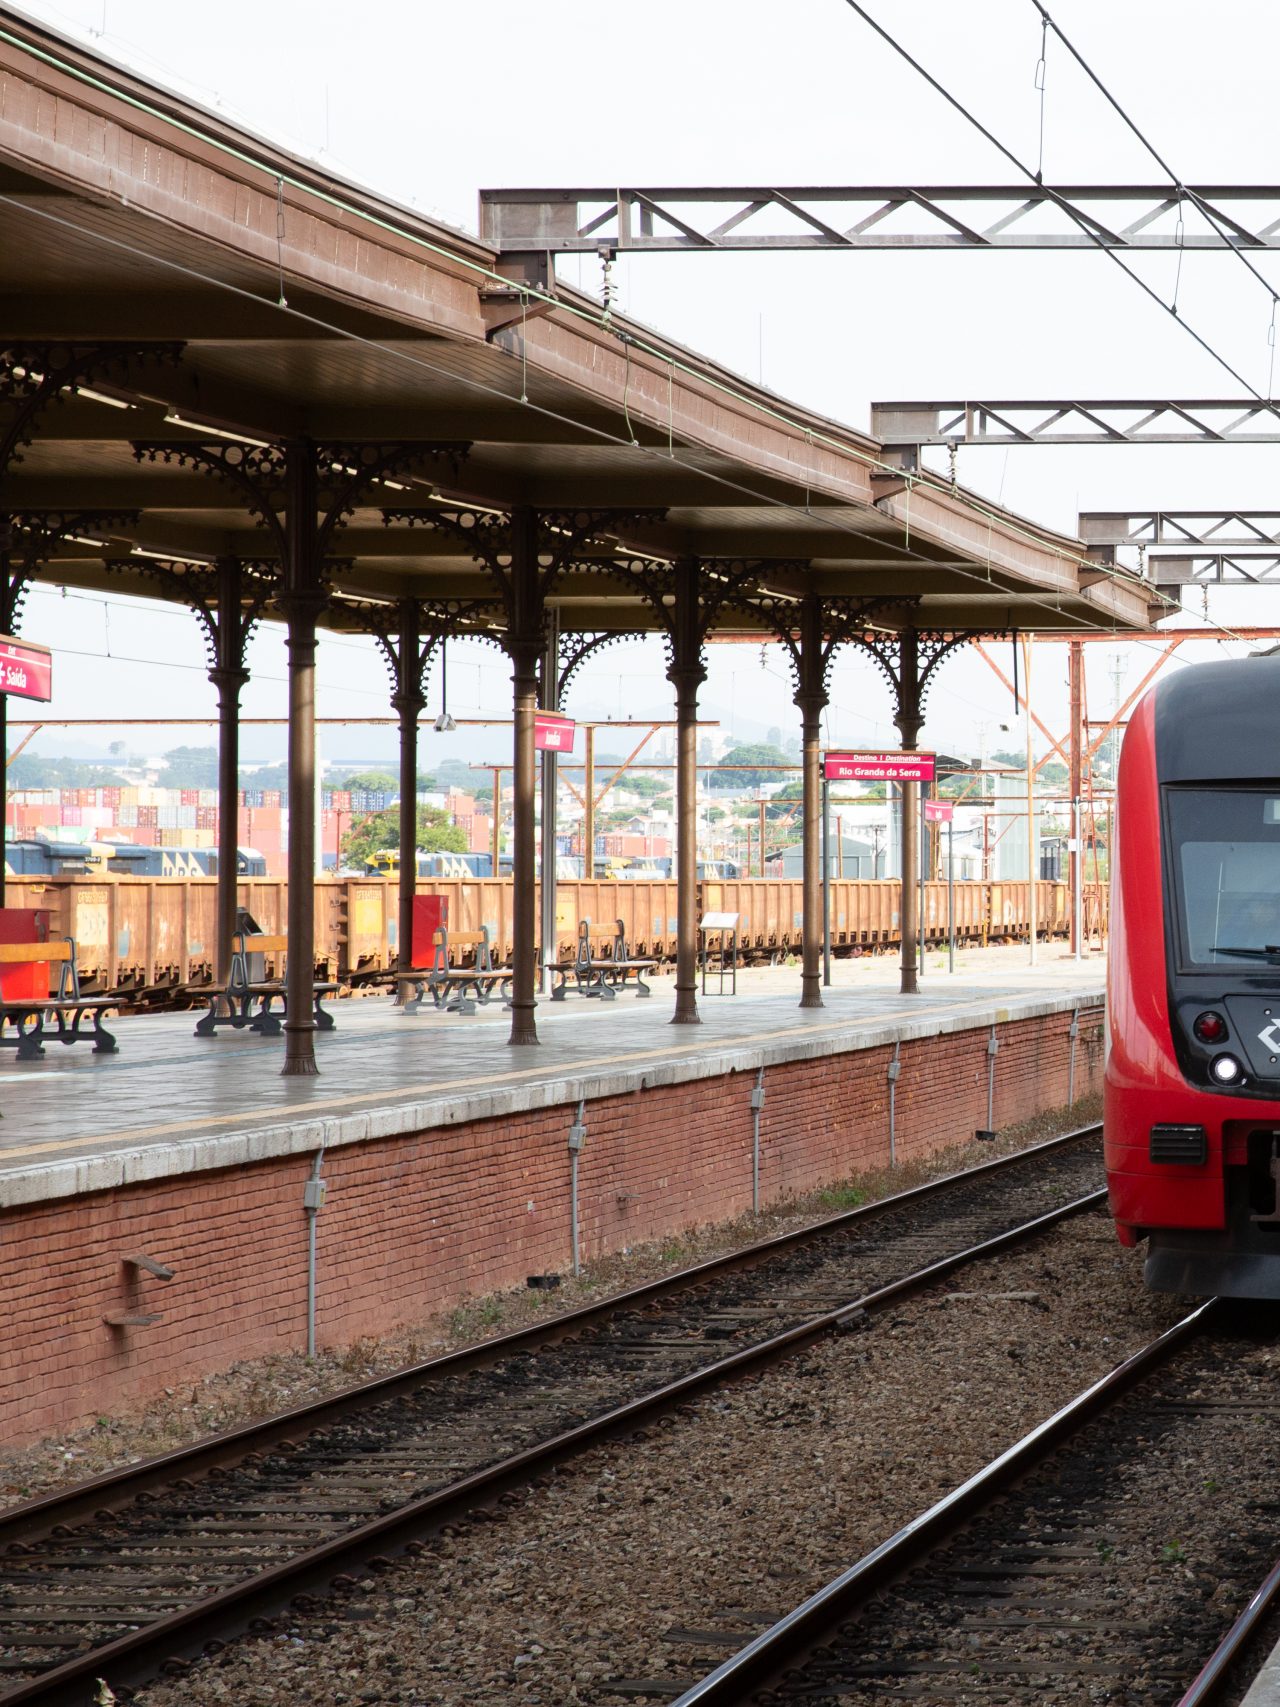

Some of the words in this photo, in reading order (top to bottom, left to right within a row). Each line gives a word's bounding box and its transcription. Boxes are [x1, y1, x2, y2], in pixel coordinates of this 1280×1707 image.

[7, 666, 27, 689] Saída
[839, 767, 852, 776] Rio
[854, 767, 885, 777] Grande
[886, 768, 897, 776] da
[899, 768, 921, 777] Serra
